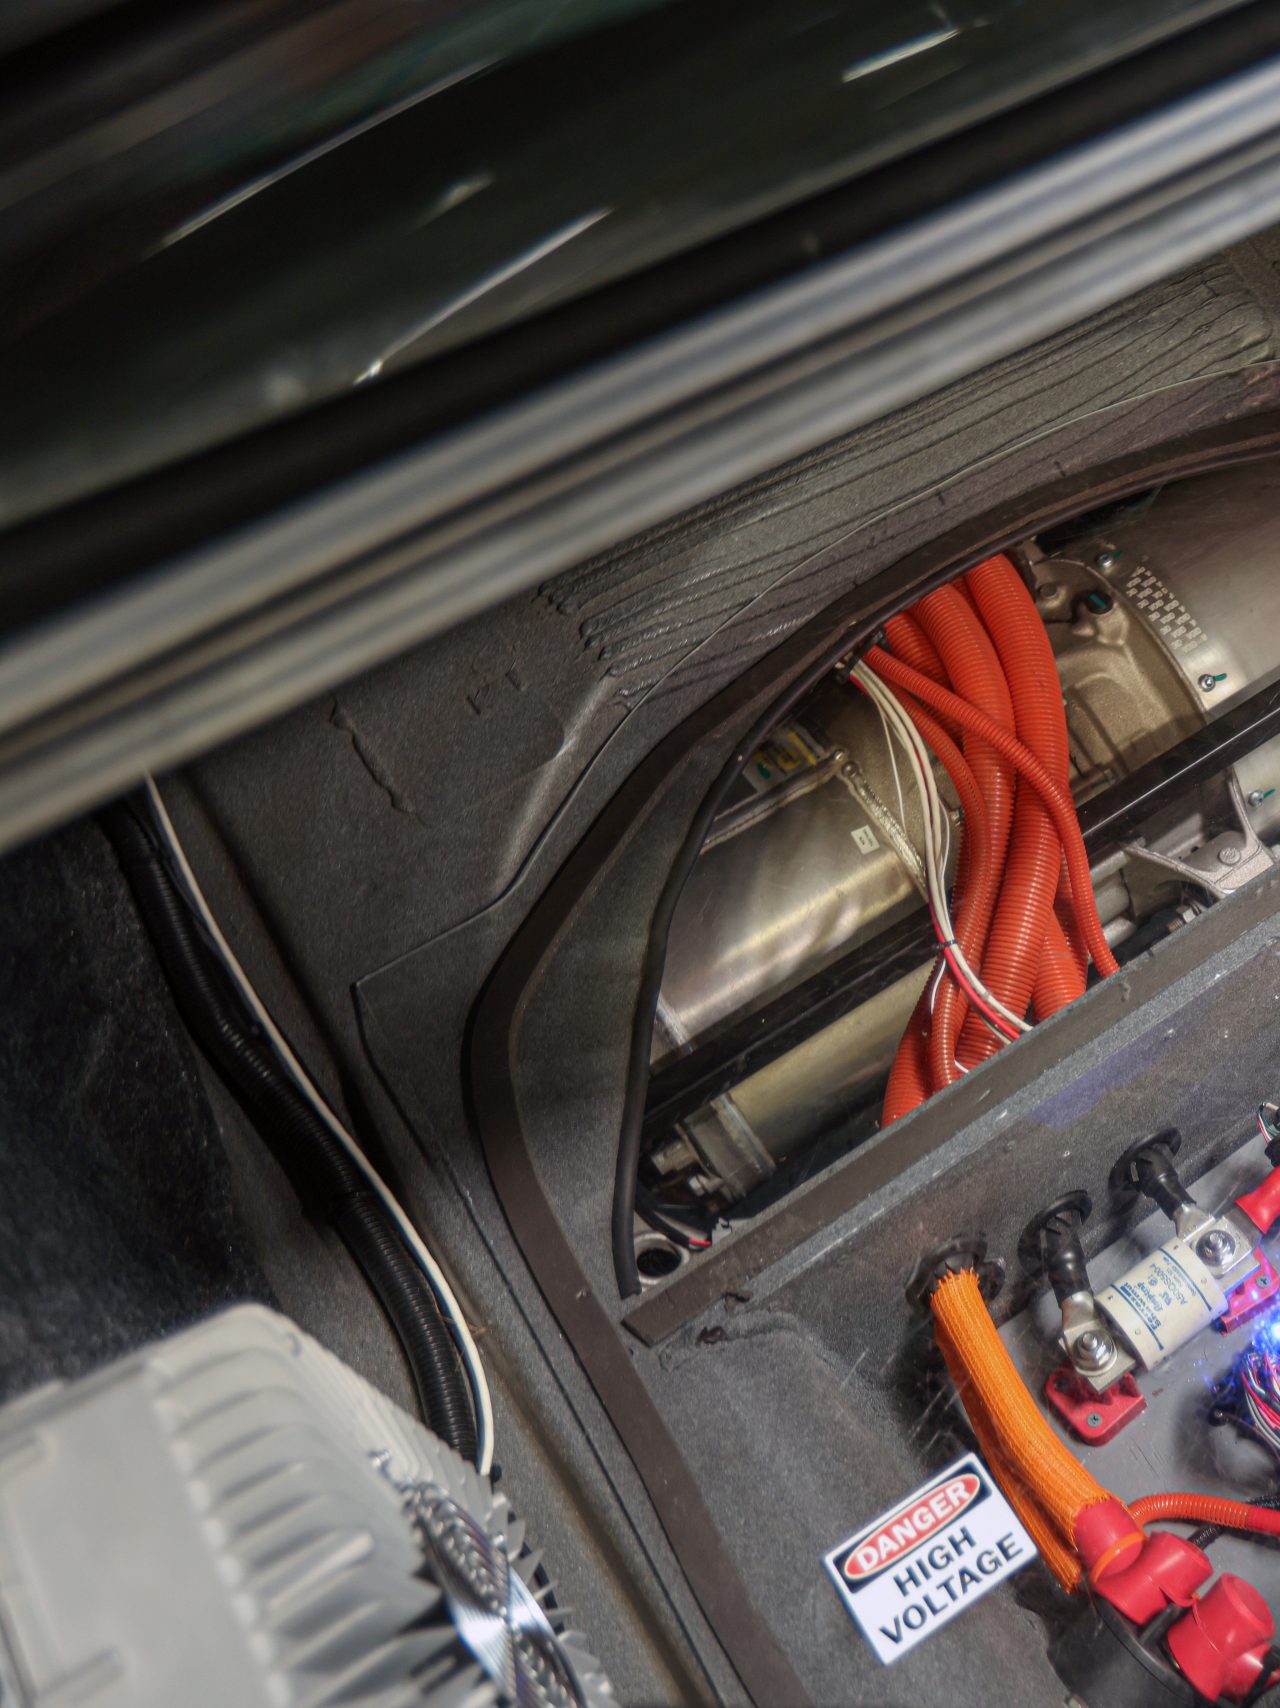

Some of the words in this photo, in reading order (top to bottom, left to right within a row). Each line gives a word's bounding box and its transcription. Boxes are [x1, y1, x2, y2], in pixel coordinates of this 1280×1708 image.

[857, 1480, 970, 1573] DANGER
[894, 1526, 976, 1597] HIGH
[879, 1532, 1023, 1645] VOLTAGE
